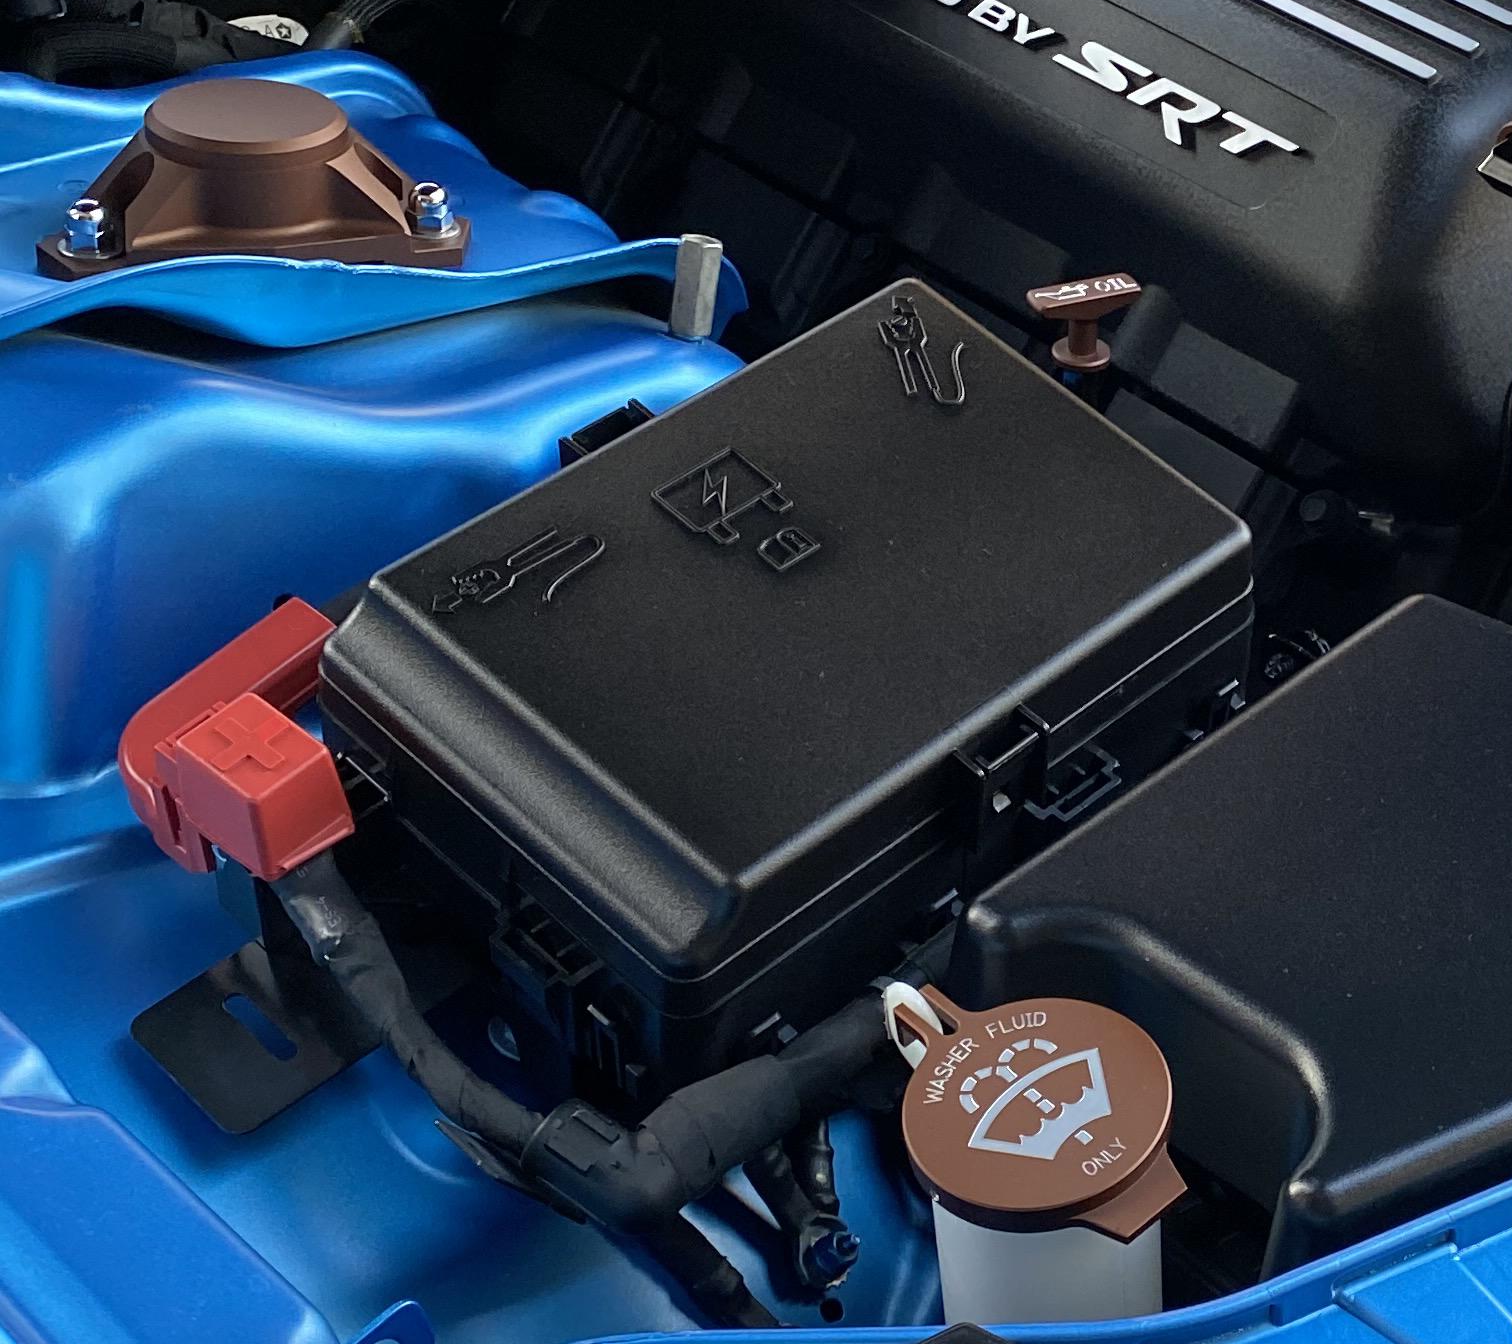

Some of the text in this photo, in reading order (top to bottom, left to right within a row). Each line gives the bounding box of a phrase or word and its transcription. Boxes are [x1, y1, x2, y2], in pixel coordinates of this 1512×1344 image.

[1051, 40, 1301, 155] SRT
[1094, 277, 1138, 292] OIL
[923, 1010, 1048, 1105] WASHER FLUID
[1081, 1136, 1128, 1177] ONLY
